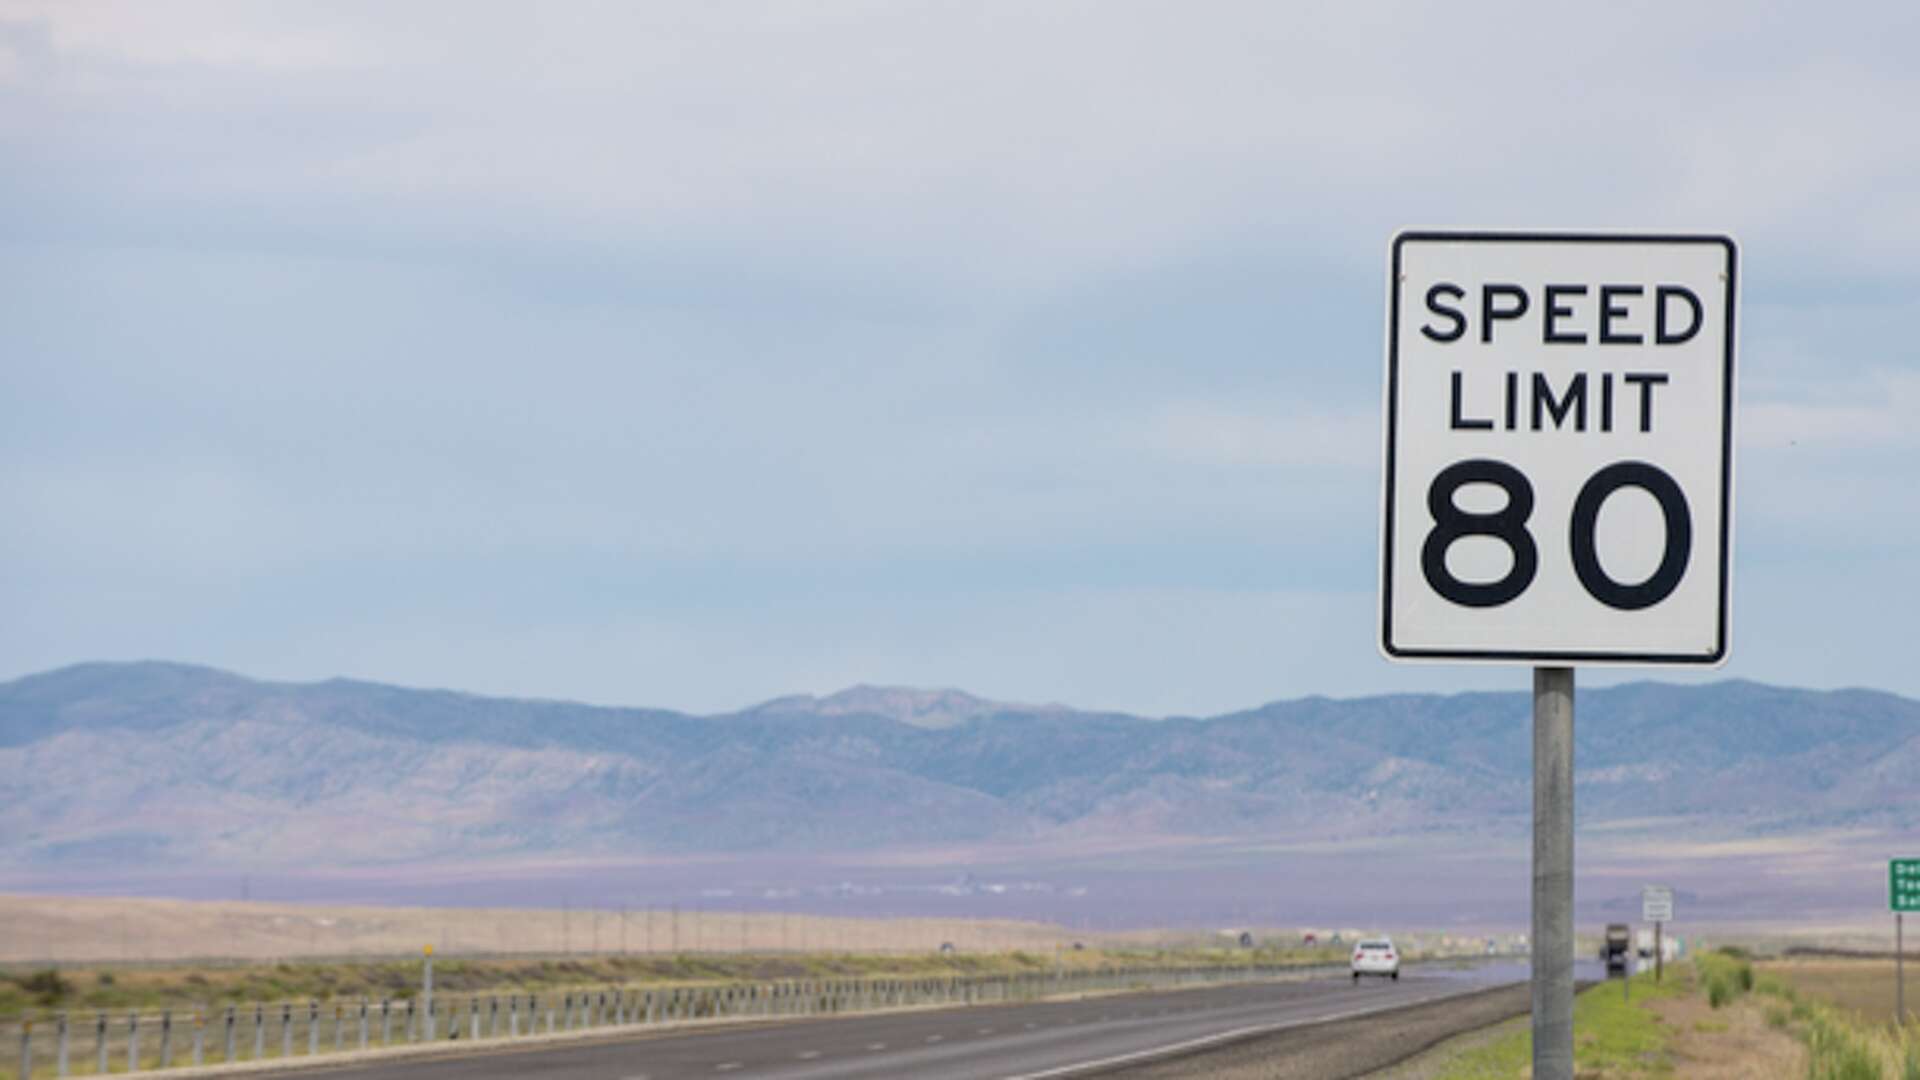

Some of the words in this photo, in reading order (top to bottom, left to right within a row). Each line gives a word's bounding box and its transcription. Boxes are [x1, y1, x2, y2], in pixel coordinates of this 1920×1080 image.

[1420, 284, 1704, 345] SPEED
[1450, 371, 1669, 433] LIMIT
[1420, 459, 1692, 611] 80
